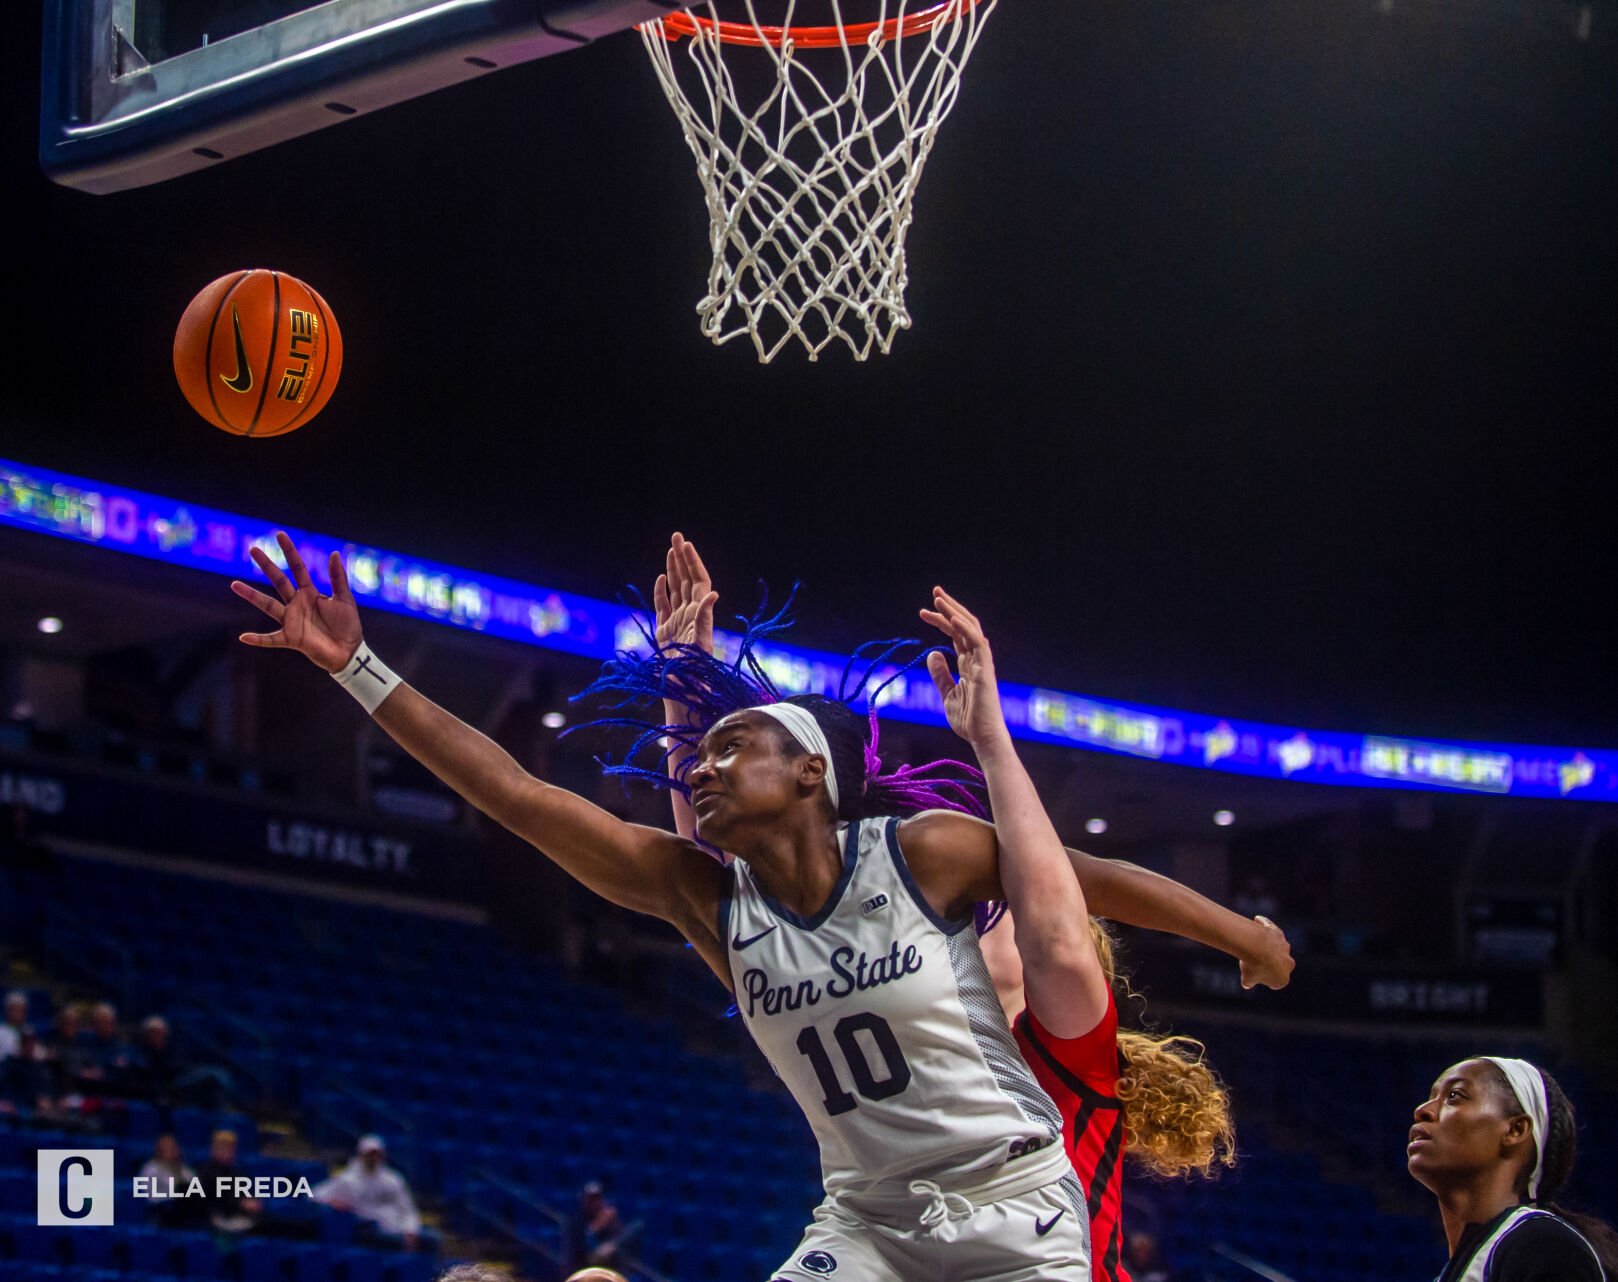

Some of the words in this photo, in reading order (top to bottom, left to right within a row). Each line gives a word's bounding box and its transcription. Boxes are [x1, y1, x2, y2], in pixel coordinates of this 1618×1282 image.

[277, 309, 312, 402] ELITE
[266, 821, 412, 872] LOYALTY
[743, 968, 821, 1018] Penn
[826, 940, 923, 999] State
[796, 1011, 912, 1116] 10
